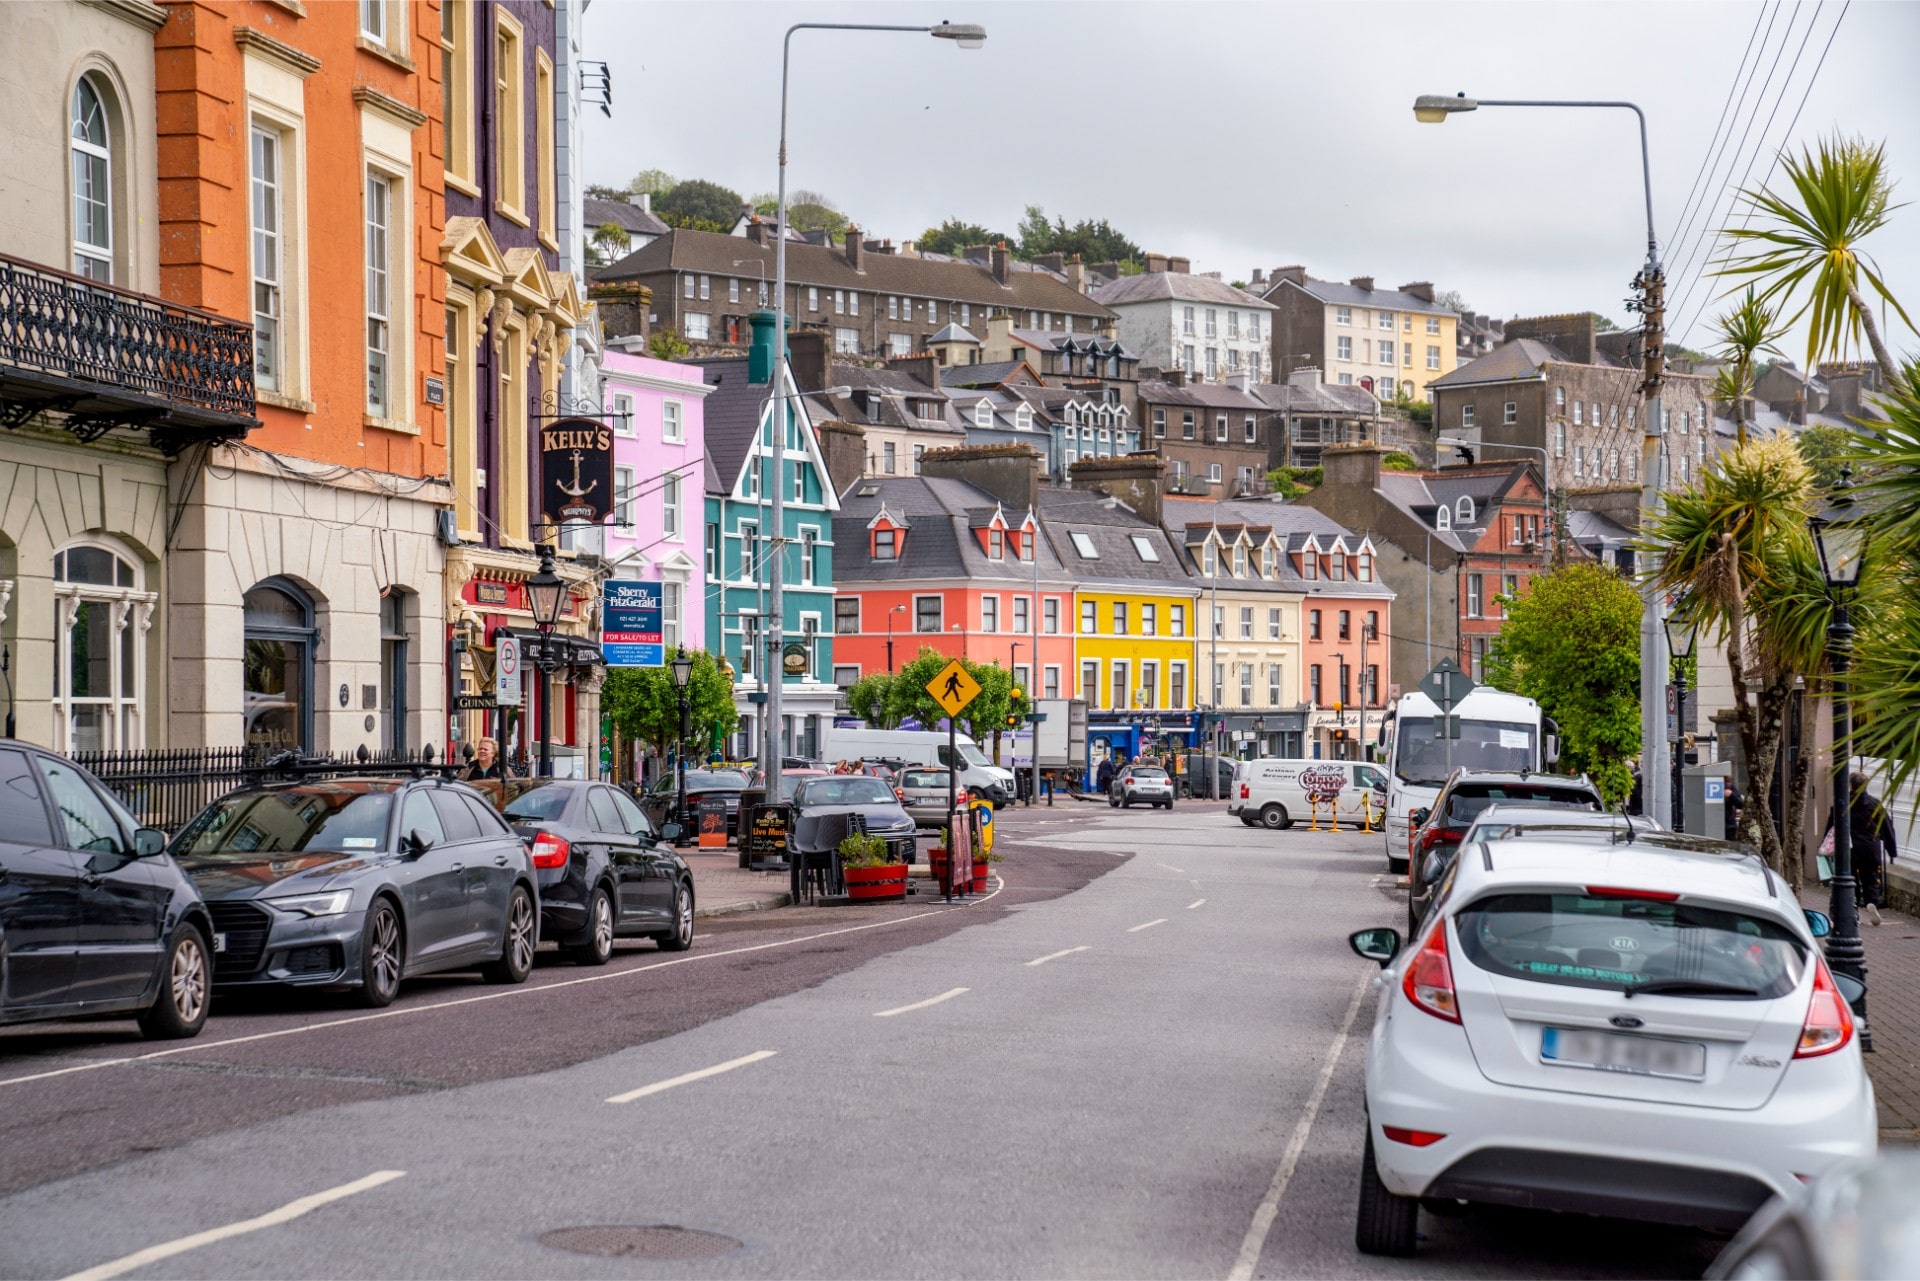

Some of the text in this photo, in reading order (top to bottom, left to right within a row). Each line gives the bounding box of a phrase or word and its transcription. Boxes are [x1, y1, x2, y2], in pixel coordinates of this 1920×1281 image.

[543, 425, 610, 452] KELLY'S
[617, 586, 648, 598] Sherry
[610, 596, 656, 608] FitzGerald
[460, 697, 497, 708] GUINNE
[1709, 784, 1720, 797] P
[752, 827, 767, 836] Live
[1613, 938, 1635, 949] KIA
